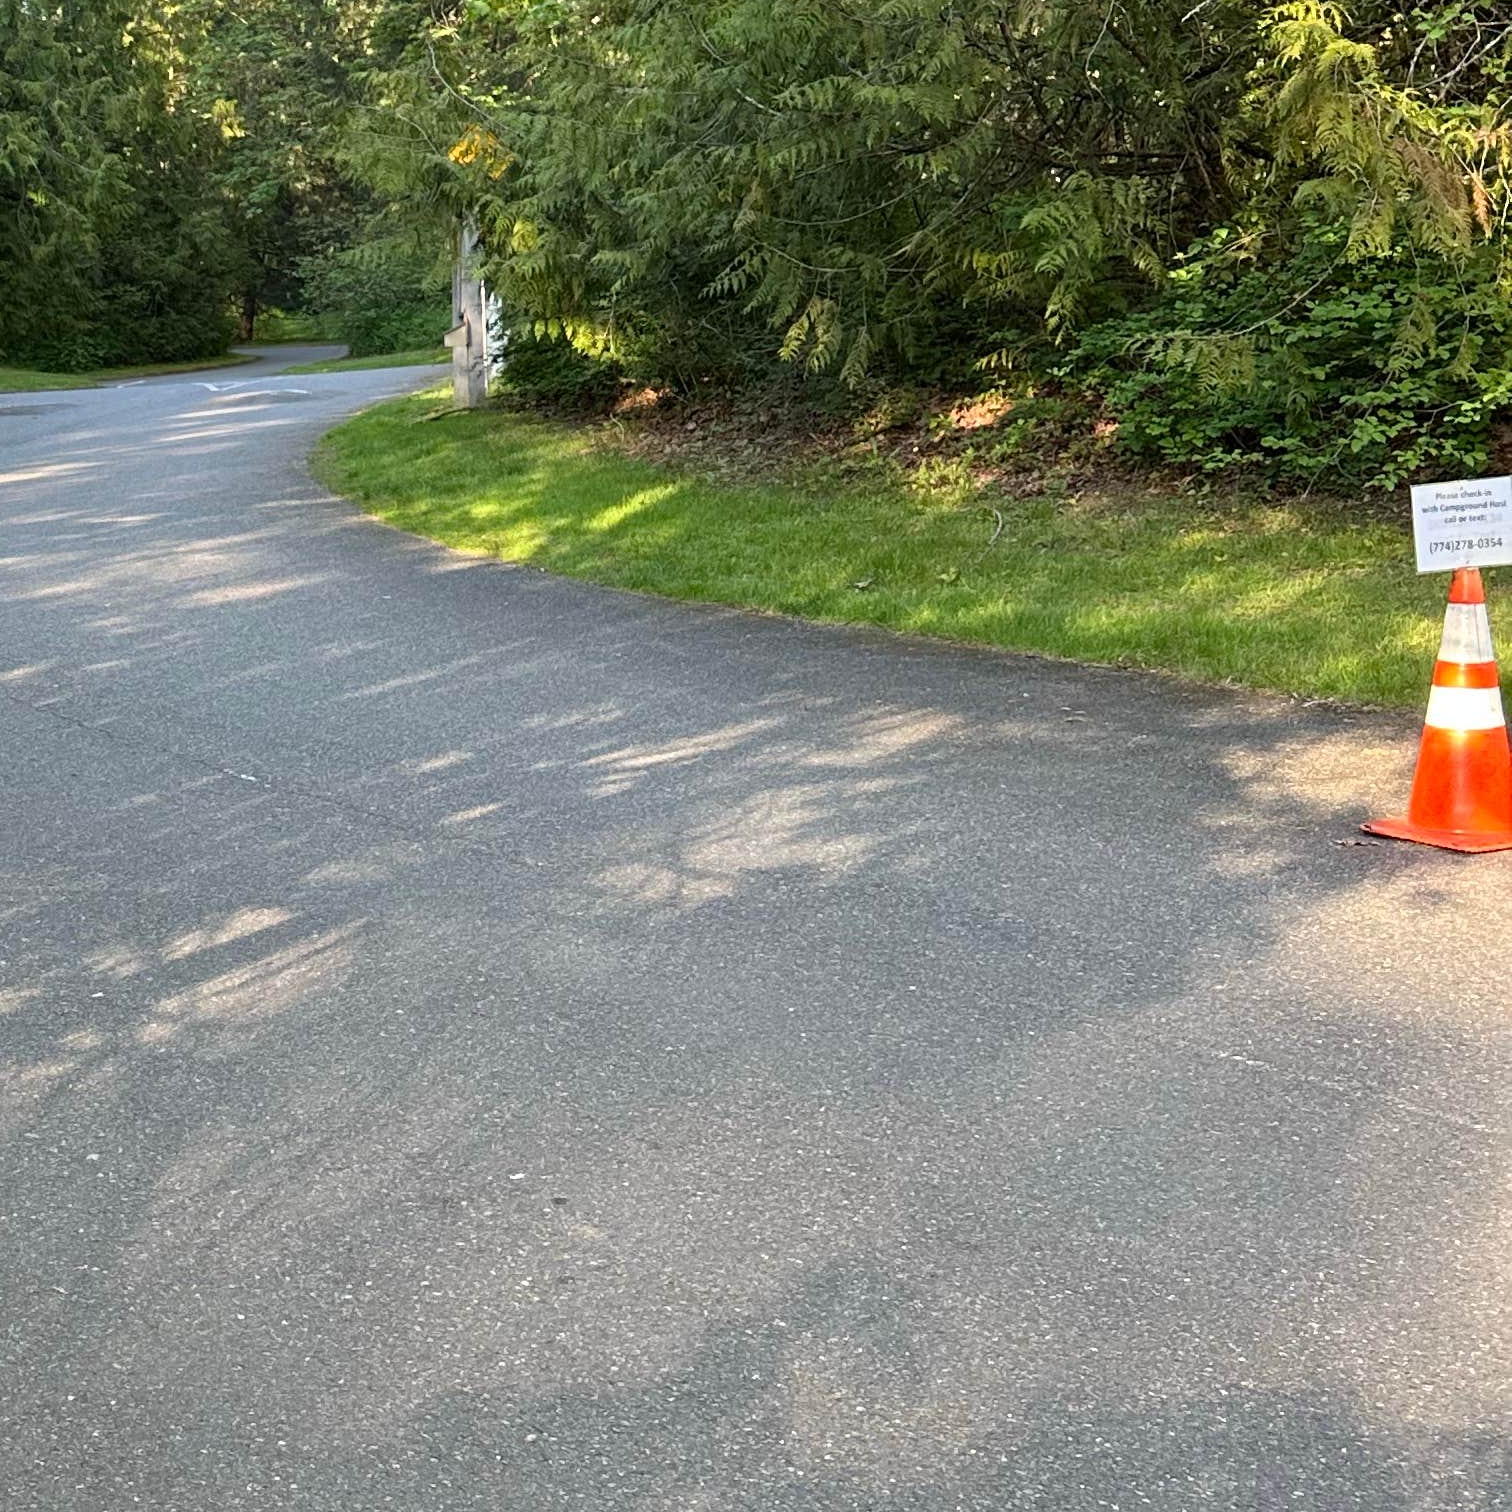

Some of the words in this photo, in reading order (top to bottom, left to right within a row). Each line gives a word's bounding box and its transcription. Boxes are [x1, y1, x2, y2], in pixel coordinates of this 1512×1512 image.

[1435, 492, 1458, 500] Please
[1460, 489, 1492, 498] check-in
[1422, 504, 1439, 513] with
[1440, 501, 1488, 512] Campground
[1444, 516, 1457, 524] call
[1429, 537, 1503, 554] (774)278-0354
